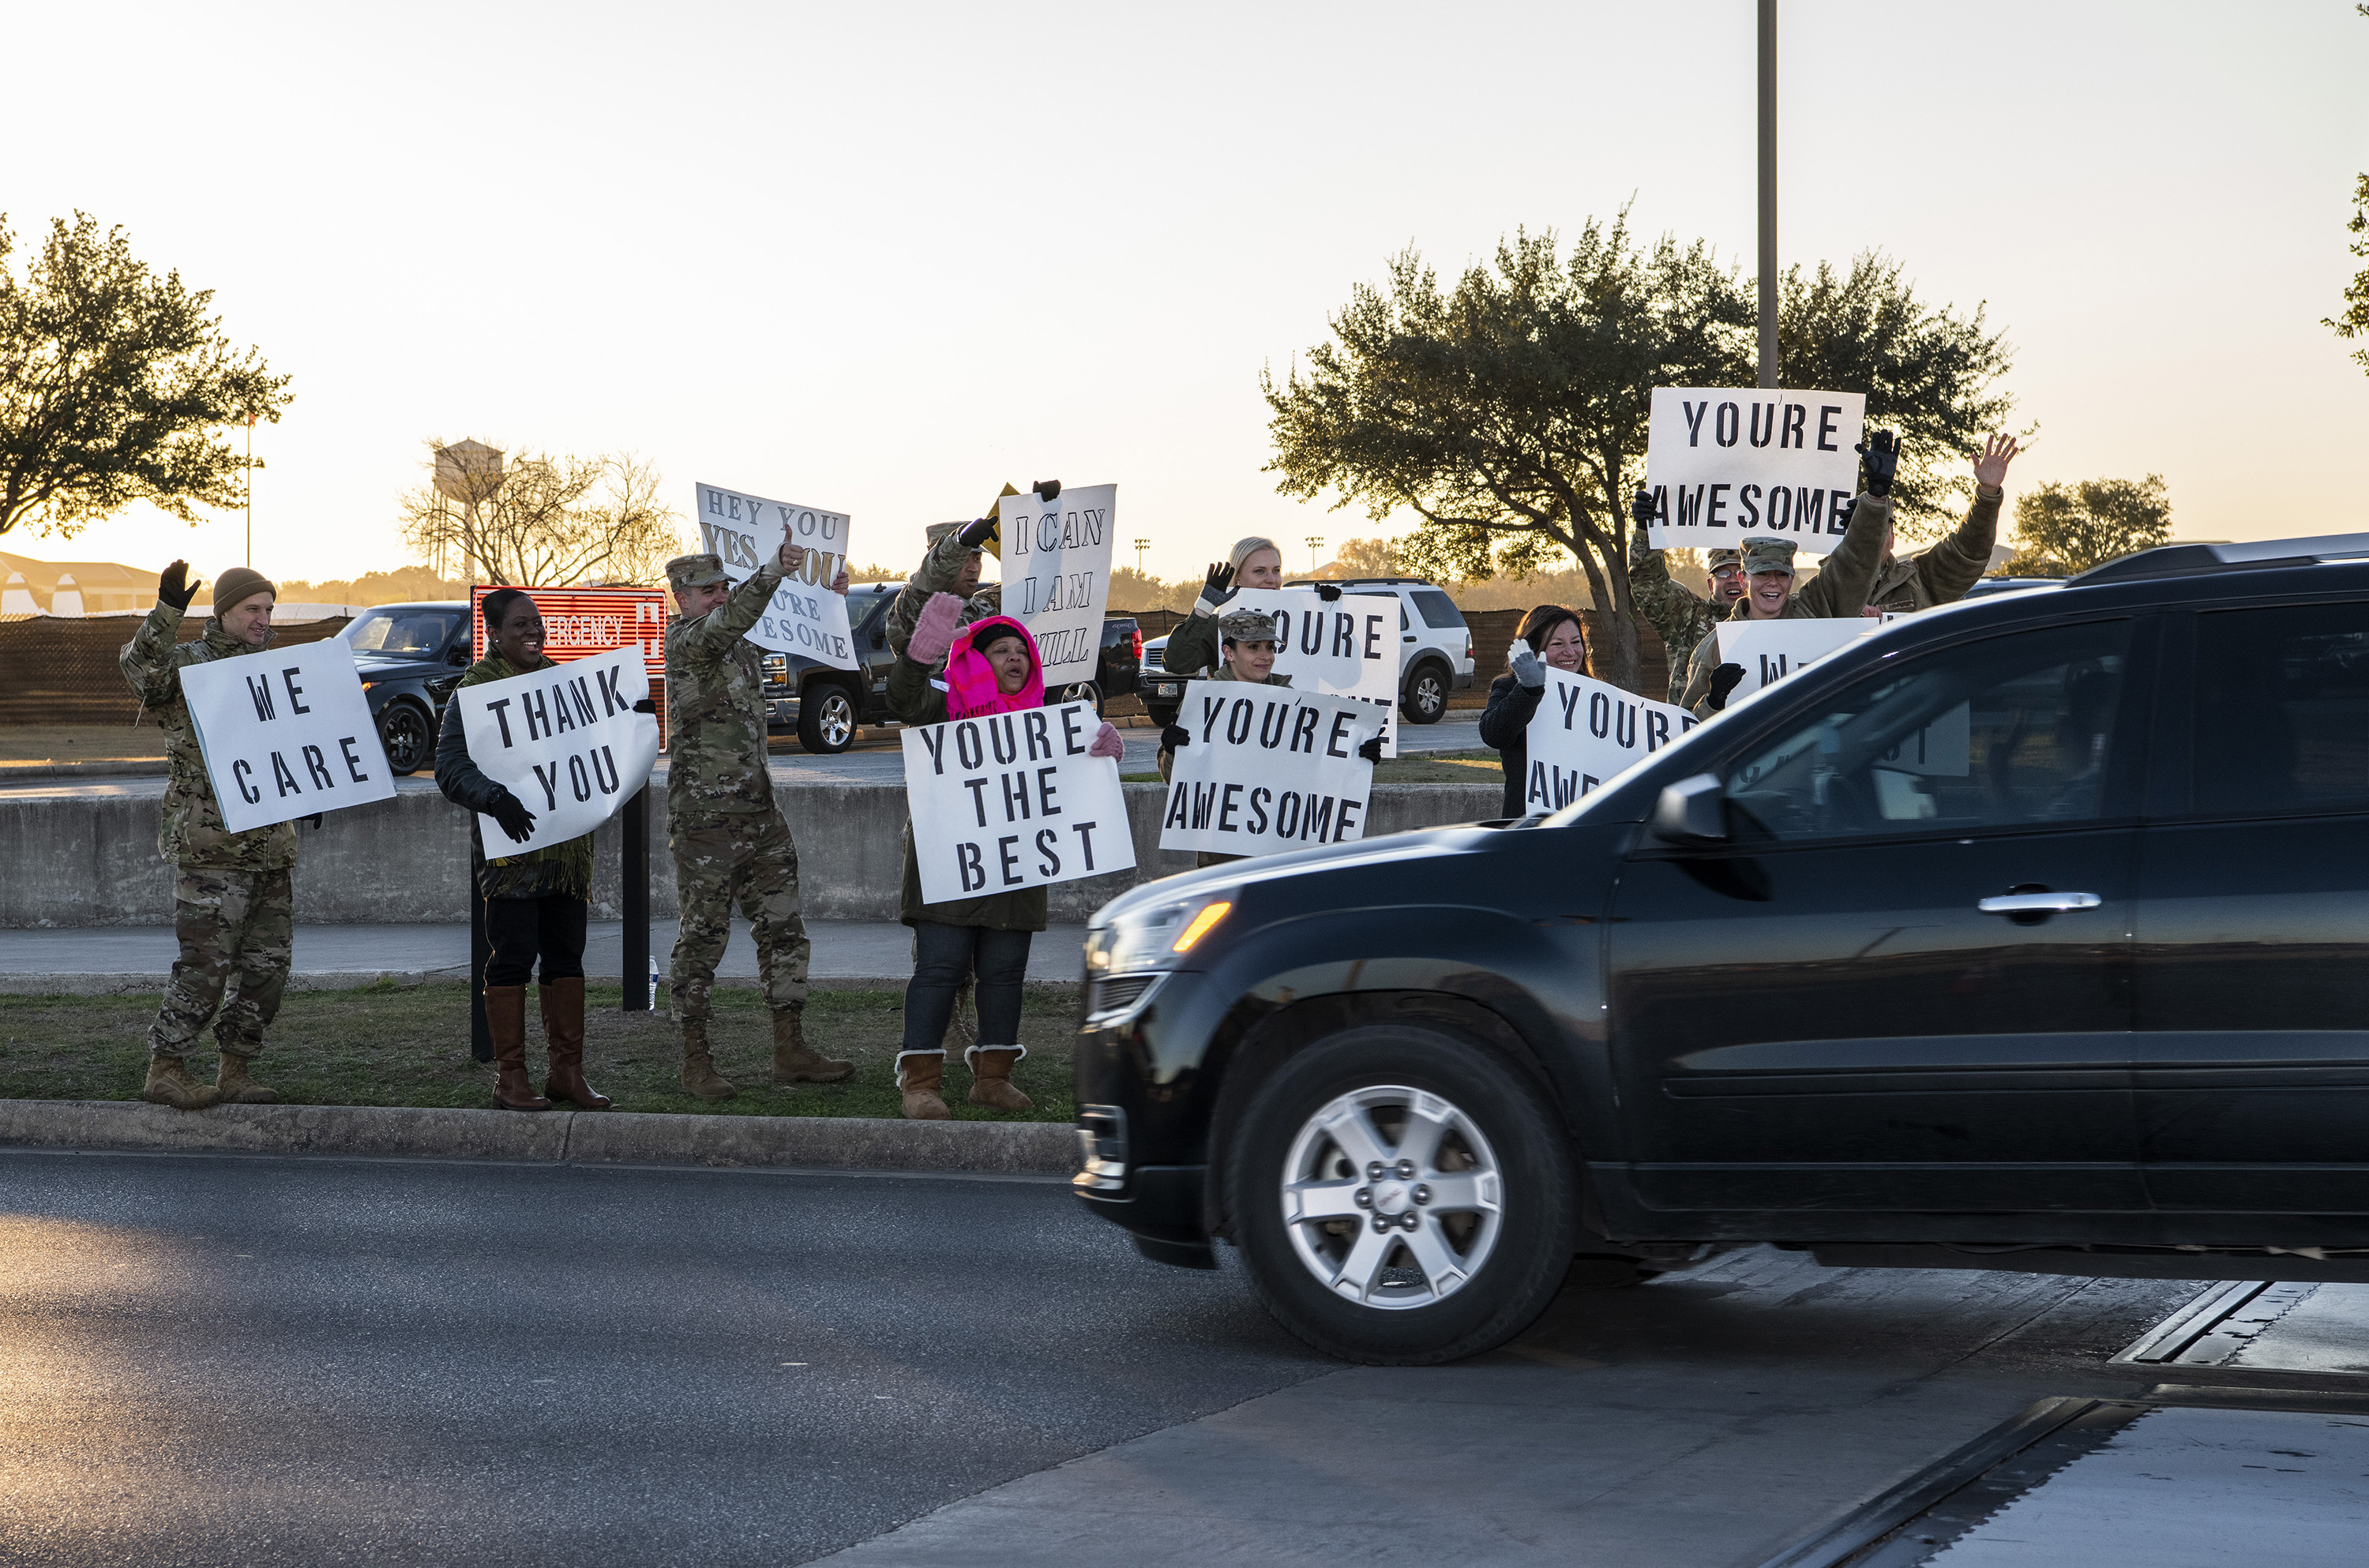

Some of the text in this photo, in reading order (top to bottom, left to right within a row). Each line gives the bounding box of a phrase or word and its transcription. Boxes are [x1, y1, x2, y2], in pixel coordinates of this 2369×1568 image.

[707, 490, 839, 540] HEY YOU
[1016, 508, 1106, 555] I CAN
[1649, 483, 1851, 536] AWESOME
[700, 522, 847, 591] YES OU
[772, 589, 821, 622] U'RE
[1023, 572, 1094, 614] I AM
[543, 616, 624, 646] ERGENCY
[751, 615, 849, 660] ESOME
[1239, 602, 1383, 660] OU'RE
[246, 666, 311, 722] WE
[486, 665, 630, 748] THANK
[919, 705, 1086, 775] YOURE
[1203, 696, 1357, 759] YOU'RE
[232, 736, 369, 805] CARE
[532, 745, 620, 812] YOU
[963, 766, 1062, 827] THE
[1165, 781, 1362, 844] AWESOME
[956, 821, 1097, 892] BEST
